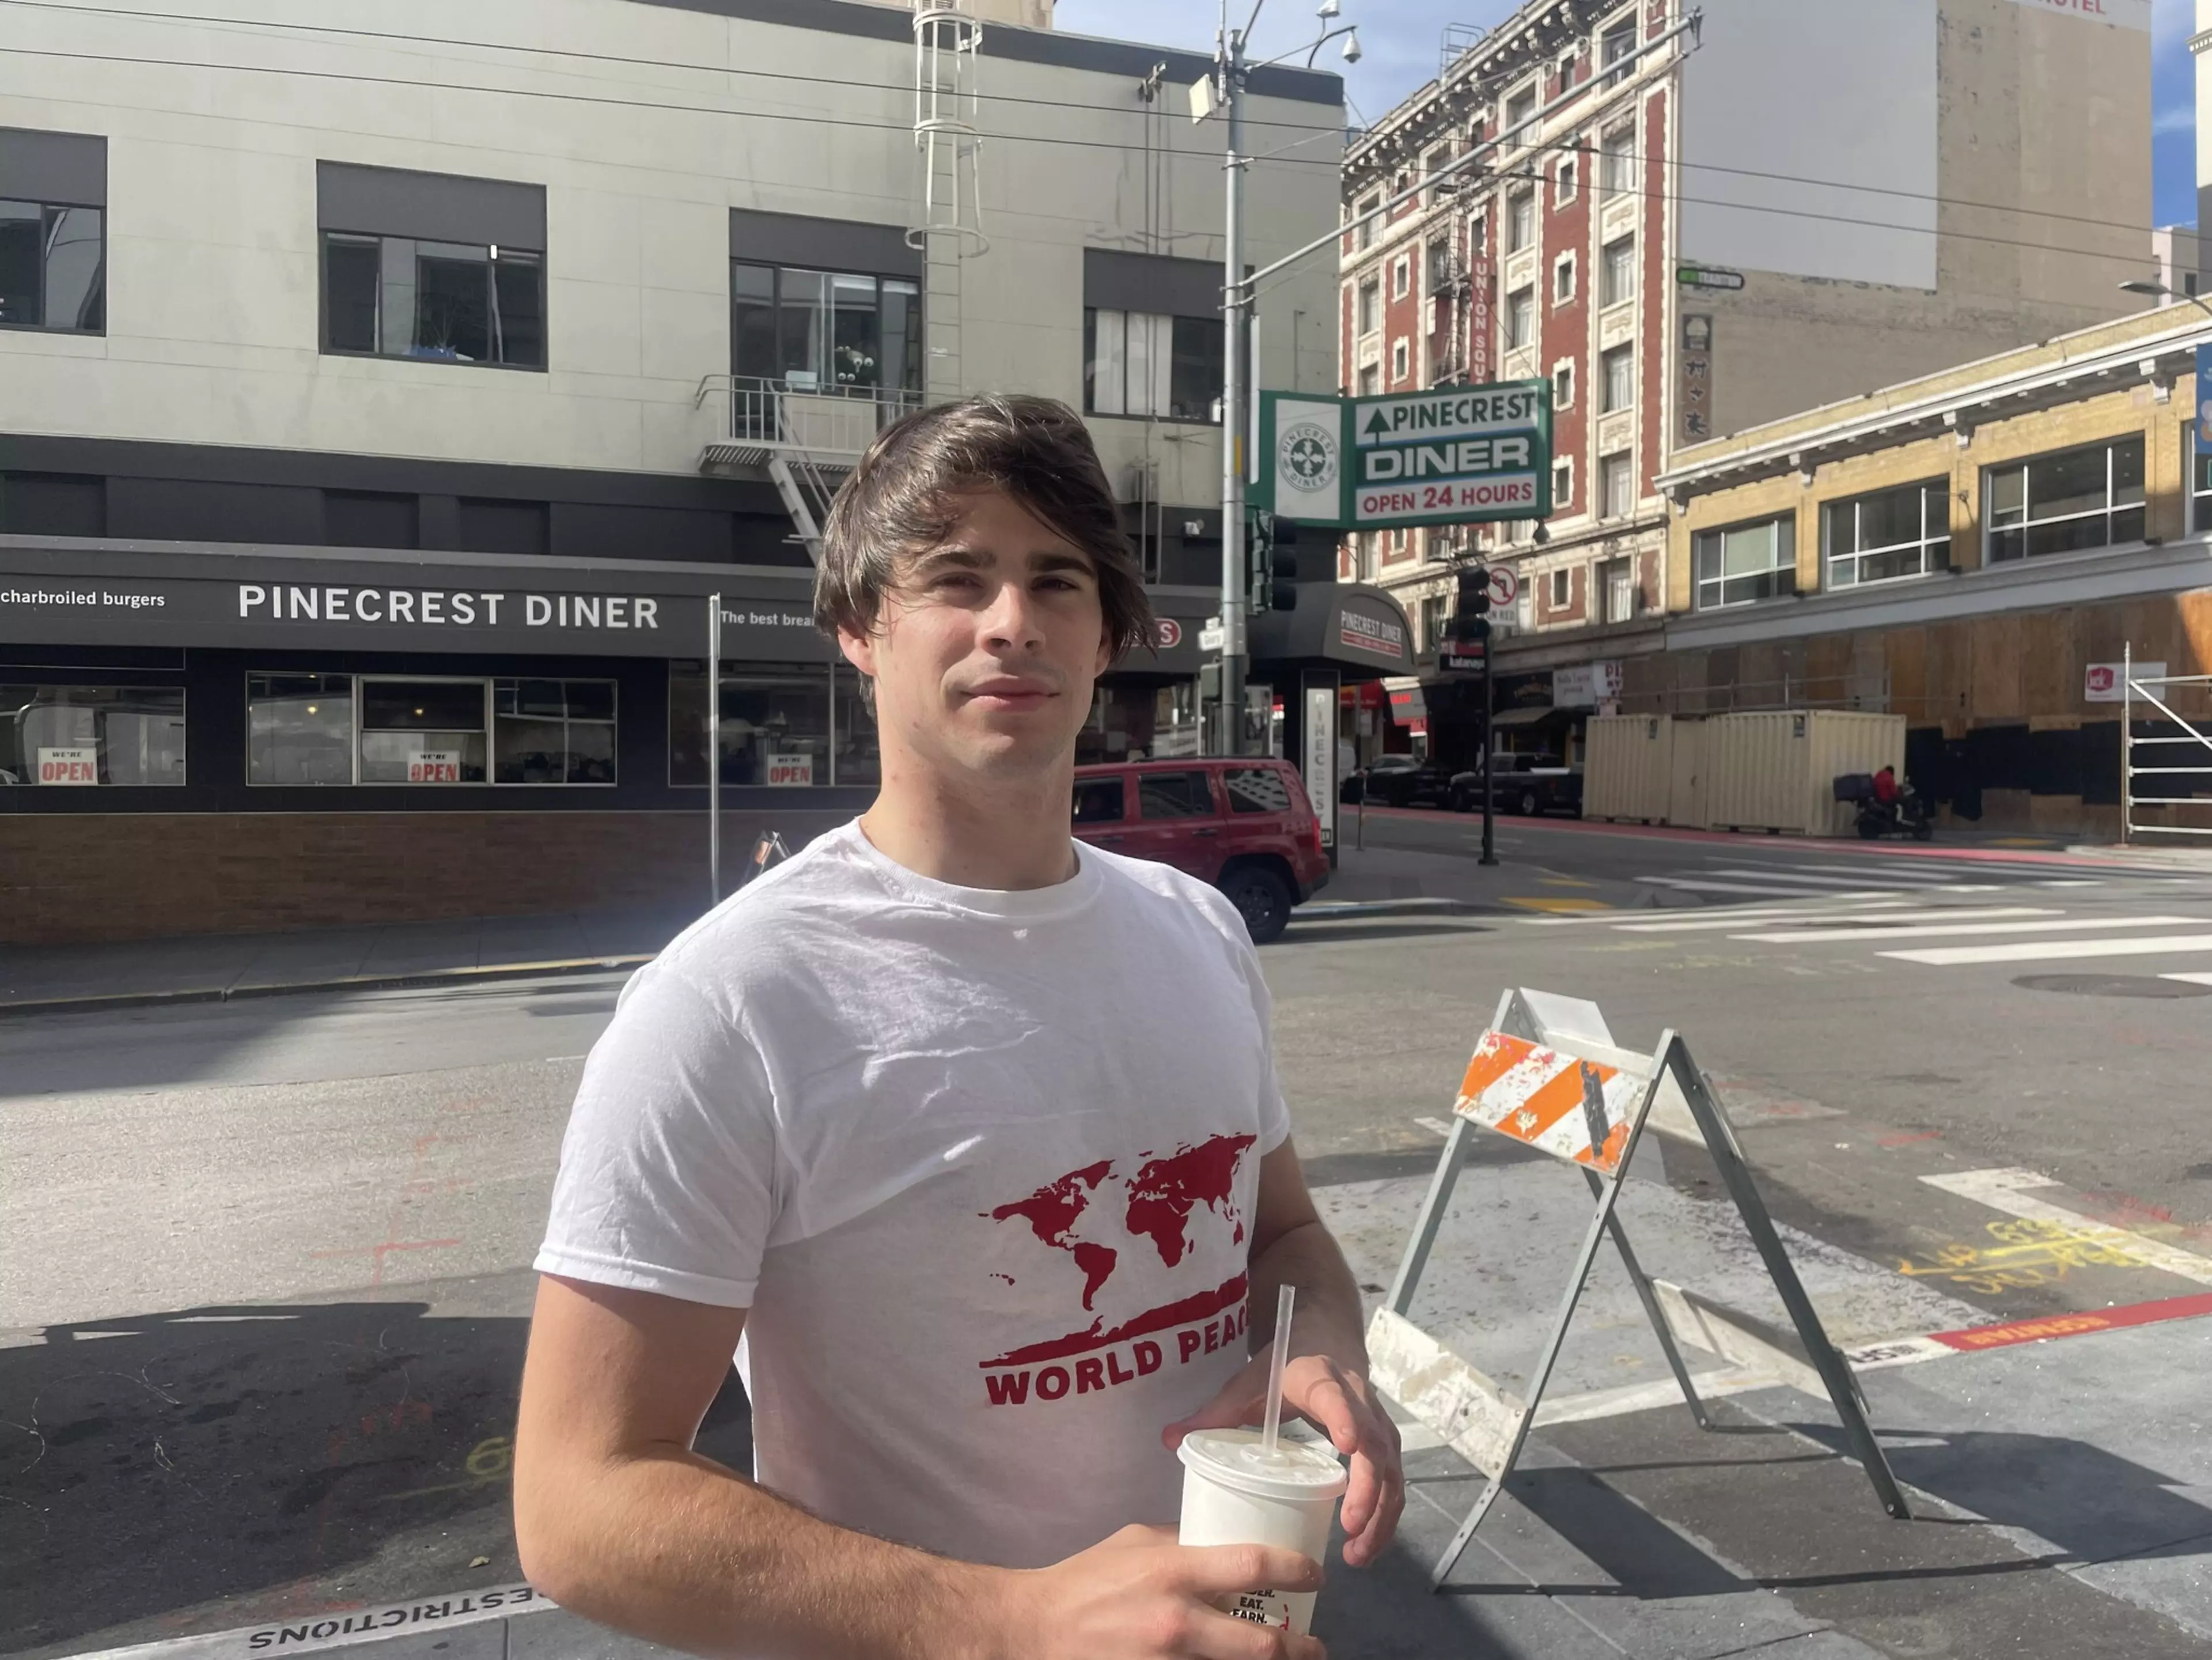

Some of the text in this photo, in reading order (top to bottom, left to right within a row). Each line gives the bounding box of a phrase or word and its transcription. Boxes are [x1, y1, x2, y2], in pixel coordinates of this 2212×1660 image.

[1475, 262, 1488, 331] UNION
[1393, 393, 1536, 432] PINECREST
[1282, 428, 1335, 456] PINECREST
[1366, 437, 1529, 481] DINER
[1290, 473, 1328, 487] DINER
[1363, 482, 1532, 513] OPEN 24 HOURS
[1, 589, 165, 609] charbroiled burgers
[239, 585, 659, 629] PINECREST DINER
[721, 610, 745, 624] The
[750, 611, 779, 625] best
[1341, 610, 1402, 642] PINECREST DINER
[42, 762, 94, 781] OPEN
[411, 763, 457, 782] OPEN
[770, 766, 810, 783] OPEN
[985, 1298, 1249, 1405] WORLD PEAC
[1239, 1595, 1264, 1610] EAT.
[249, 1587, 545, 1650] ESTRICTIONS
